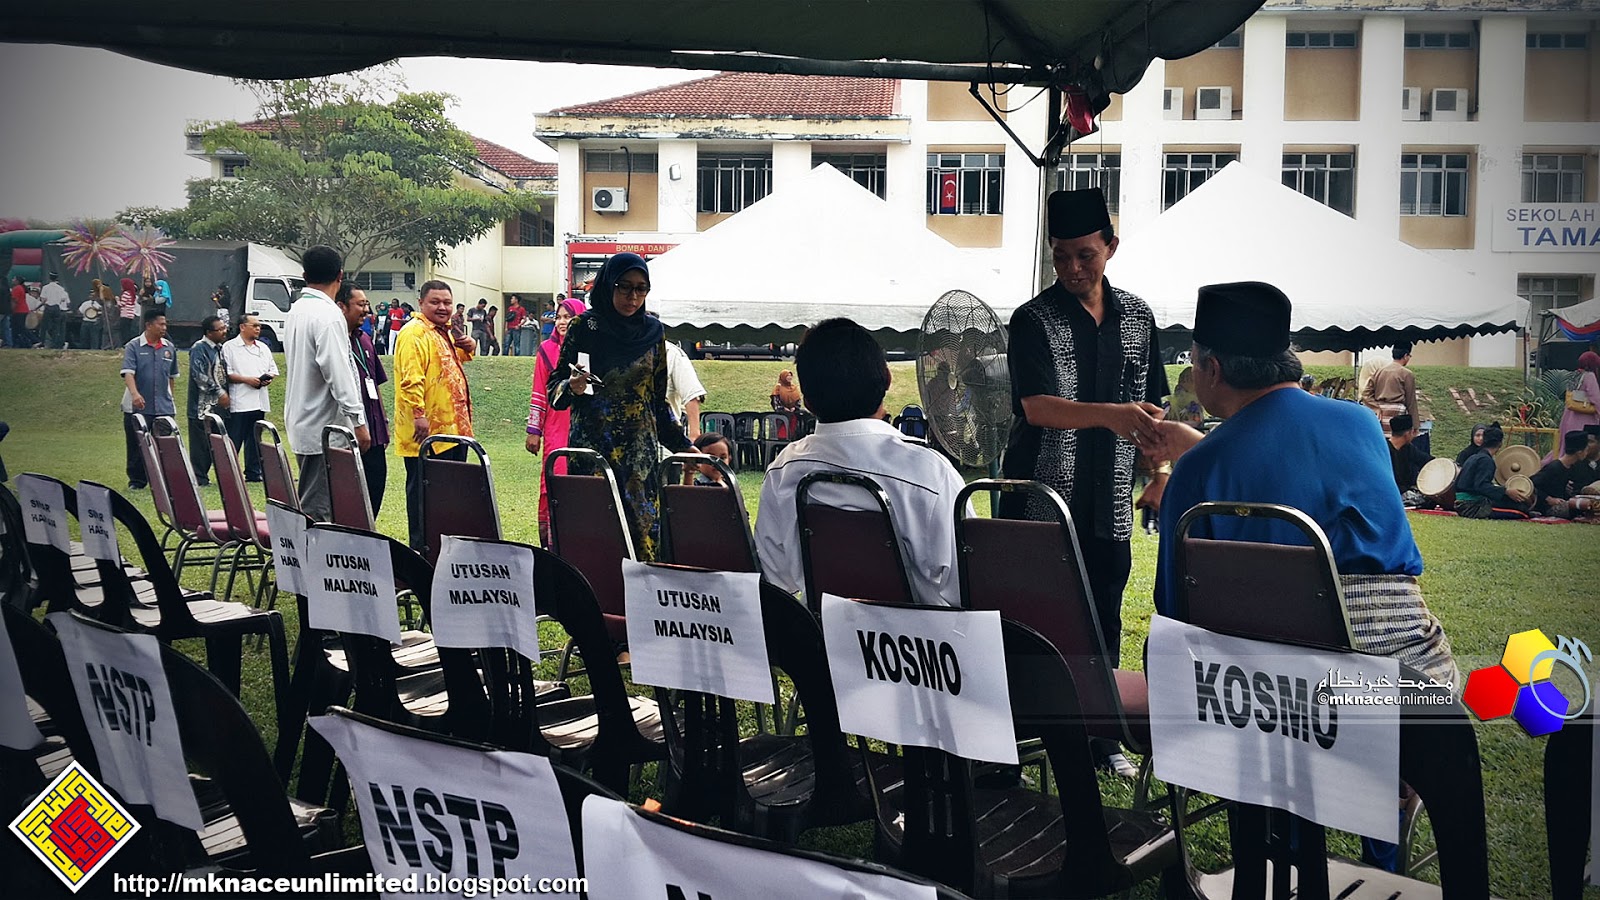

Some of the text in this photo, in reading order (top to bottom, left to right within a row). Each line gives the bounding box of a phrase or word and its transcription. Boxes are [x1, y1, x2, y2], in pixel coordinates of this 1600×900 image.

[1506, 208, 1595, 222] SEKOLAH
[615, 244, 645, 252] BOMBA
[648, 244, 664, 252] DAN
[326, 553, 371, 572] UTUSAN
[450, 563, 511, 580] UTUSAN
[323, 578, 379, 597] MALAYSIA
[449, 589, 521, 608] MALAYSIA
[656, 589, 721, 614] UTUSAN
[653, 619, 734, 646] MALAYSIA
[856, 629, 962, 697] KOSMO
[85, 662, 157, 747] NSTP
[1194, 660, 1338, 750] KOSMO
[369, 782, 521, 880] NSTP
